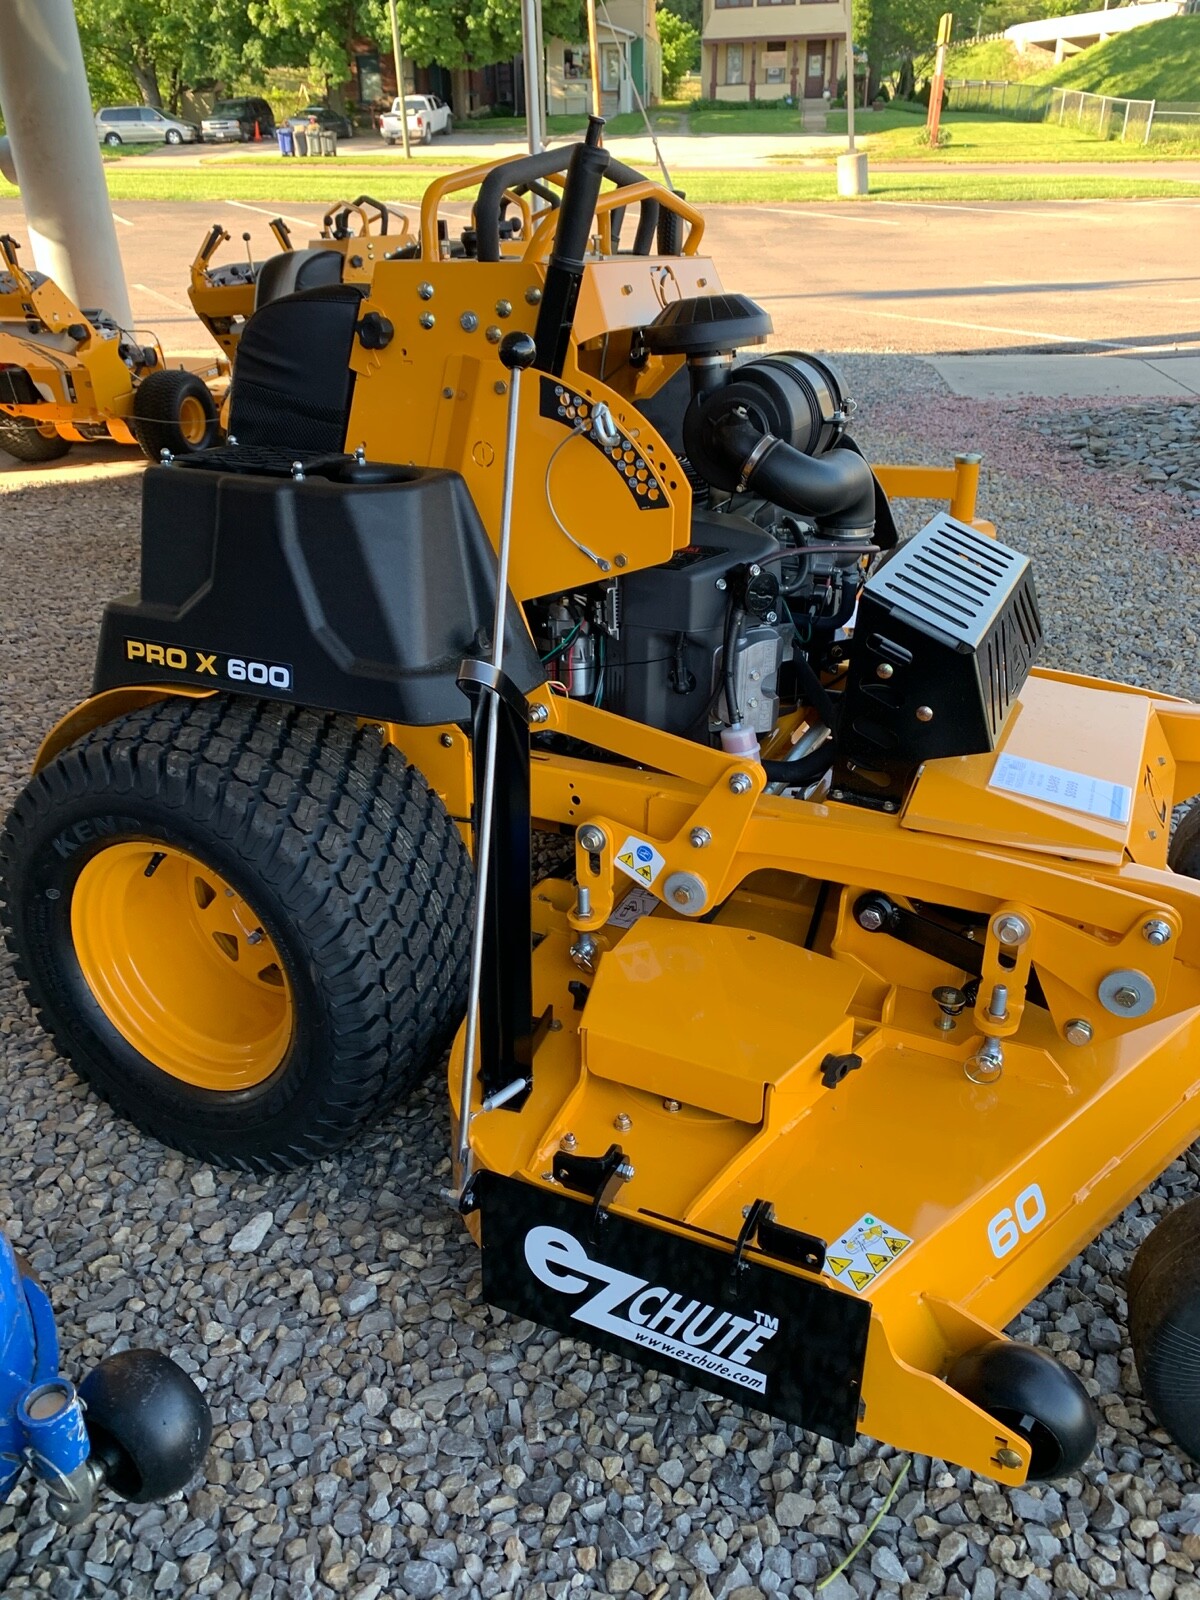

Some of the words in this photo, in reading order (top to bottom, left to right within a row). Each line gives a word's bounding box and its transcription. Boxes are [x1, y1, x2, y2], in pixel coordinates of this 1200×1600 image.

[126, 639, 188, 670] PRO
[195, 651, 218, 676] X
[227, 658, 290, 688] 600
[987, 1183, 1047, 1259] 60
[634, 1330, 764, 1389] www.ezchute.com
